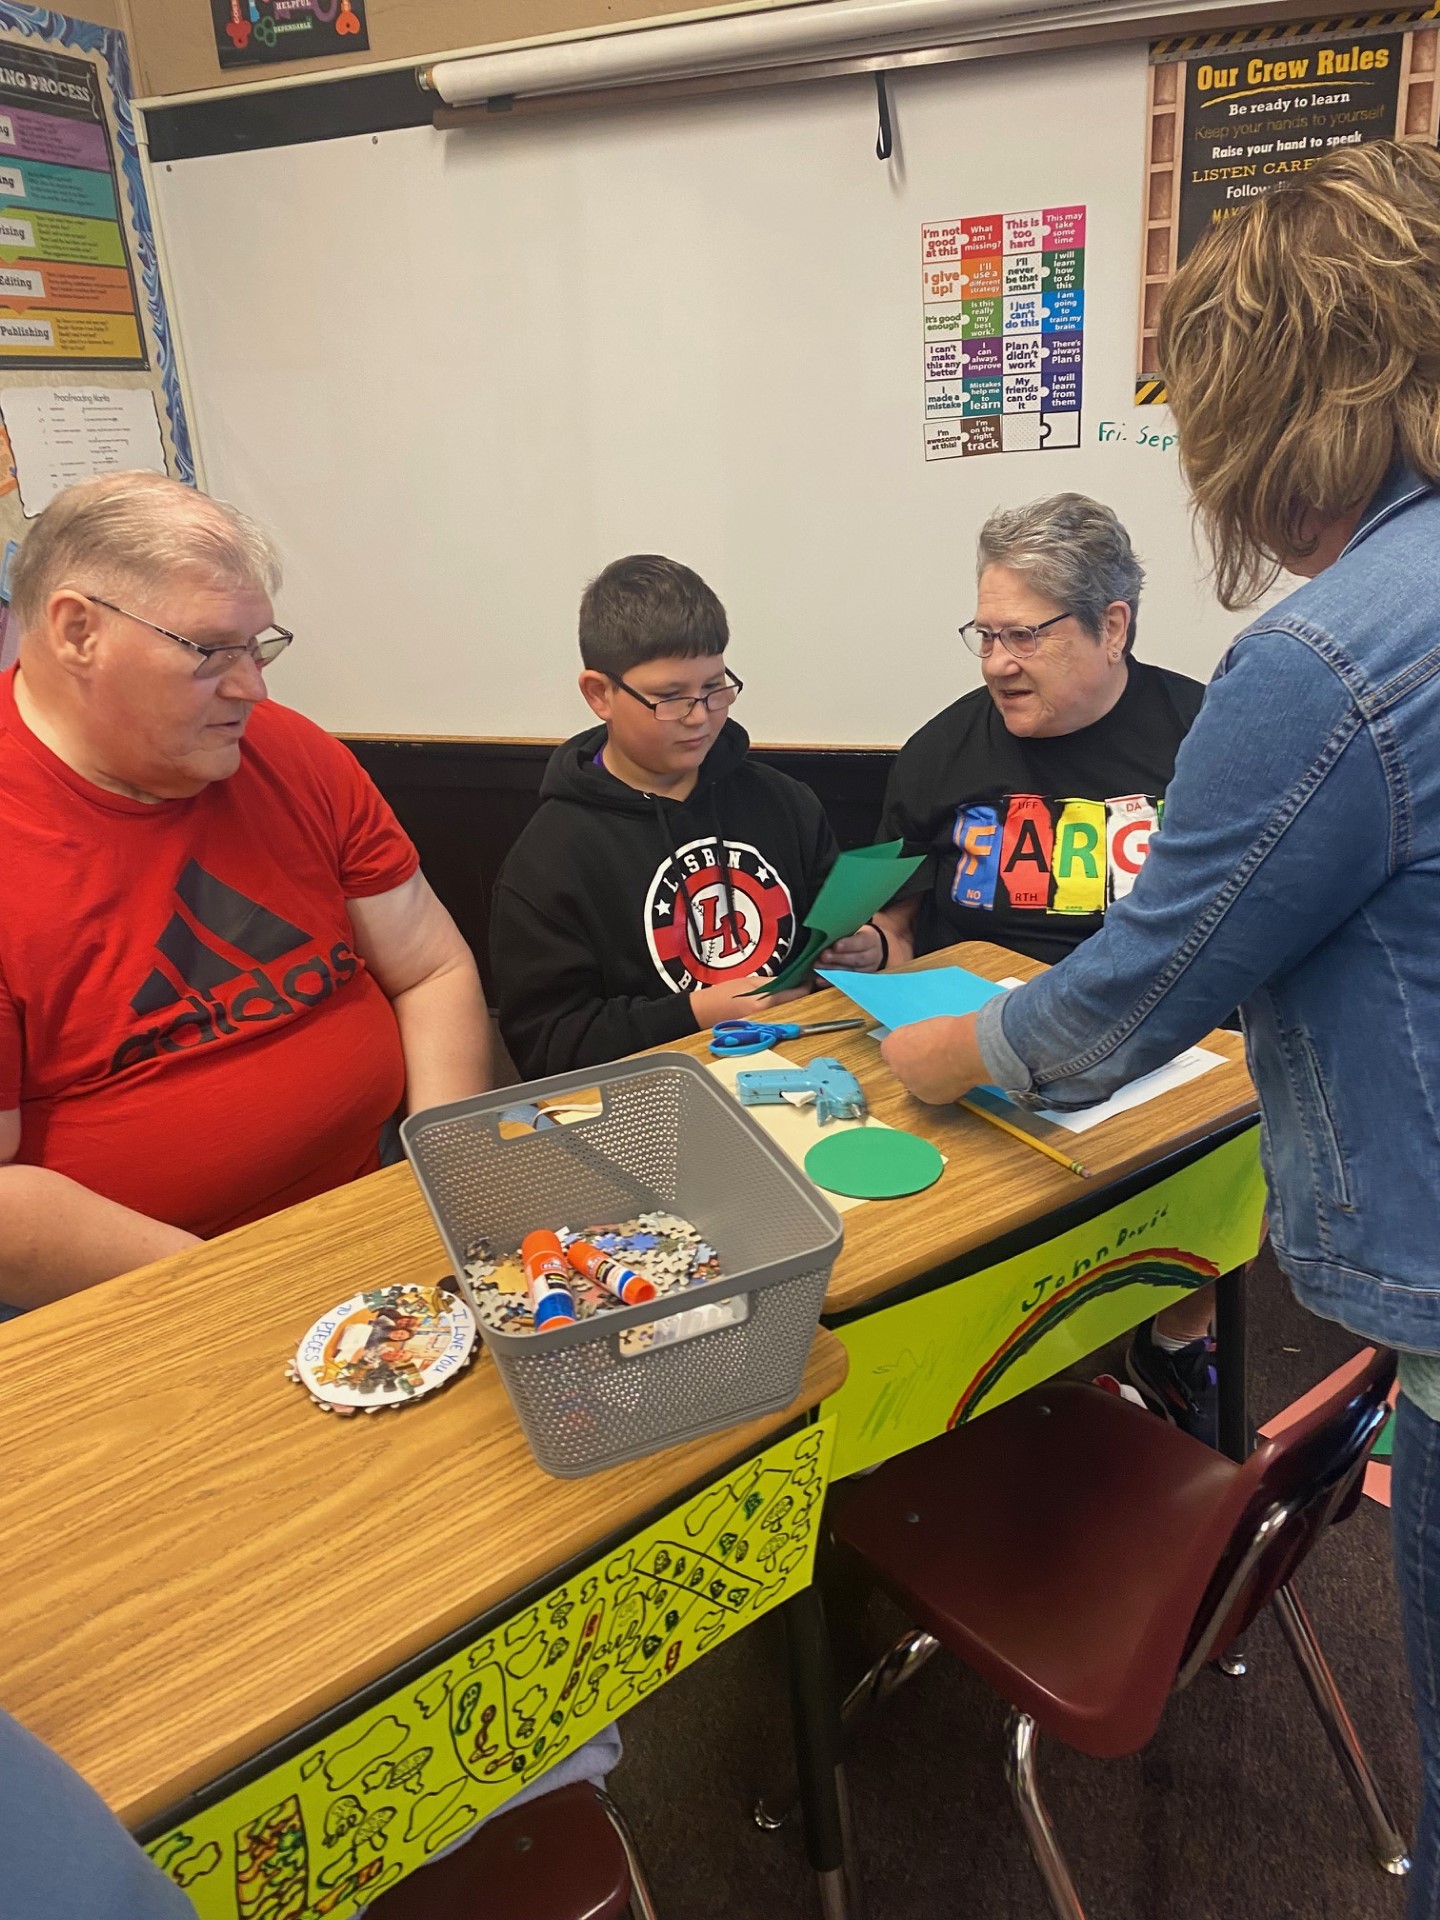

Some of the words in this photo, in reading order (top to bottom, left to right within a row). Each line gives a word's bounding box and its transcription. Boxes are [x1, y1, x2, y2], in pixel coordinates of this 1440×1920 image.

[276, 0, 312, 10] HELPFUL
[1197, 66, 1238, 91] Our
[1247, 57, 1308, 84] Crew
[1317, 46, 1390, 76] Rules
[28, 74, 91, 102] PROCESS
[1229, 104, 1247, 116] Be
[1251, 98, 1291, 114] ready
[1294, 97, 1308, 108] to
[1312, 93, 1351, 106] learn
[1195, 126, 1230, 140] Keep
[1232, 121, 1263, 138] your
[1267, 117, 1308, 132] hands
[1312, 114, 1327, 126] to
[1330, 104, 1386, 128] yourself
[1212, 146, 1243, 159] Raise
[1247, 142, 1274, 157] your
[1276, 137, 1306, 152] hand
[1310, 137, 1323, 148] to
[1327, 131, 1363, 147] speak
[1192, 164, 1257, 183] LISTEN
[1263, 157, 1322, 175] CARE
[1046, 214, 1063, 222] This
[1212, 205, 1247, 224] MAK
[1005, 219, 1028, 230] This
[1030, 218, 1039, 227] is
[1055, 221, 1074, 229] take
[923, 229, 939, 239] I'm
[942, 226, 960, 236] not
[970, 225, 993, 234] What
[1053, 229, 1075, 237] some
[1013, 230, 1032, 239] too
[928, 236, 956, 249] good
[965, 241, 1001, 251] missing?
[1010, 237, 1035, 249] hard
[926, 249, 936, 258] at
[938, 246, 958, 256] this
[1060, 251, 1075, 259] will
[1016, 257, 1027, 266] I'll
[979, 262, 992, 272] I'll
[1008, 267, 1035, 275] never
[1055, 267, 1073, 275] how
[924, 272, 928, 284] I
[931, 270, 960, 285] give
[973, 271, 990, 279] use
[1006, 275, 1017, 284] be
[1019, 274, 1038, 282] that
[0, 275, 33, 290] Editing
[969, 279, 1000, 287] different
[1056, 282, 1072, 290] this
[931, 282, 953, 296] up!
[1008, 283, 1035, 292] smart
[1010, 302, 1013, 310] I
[1016, 301, 1035, 311] just
[1054, 300, 1077, 308] going
[972, 307, 994, 315] really
[1010, 310, 1035, 319] can't
[939, 313, 961, 323] good
[976, 315, 989, 323] my
[927, 322, 959, 330] enough
[1005, 320, 1018, 328] do
[1020, 319, 1039, 327] this
[0, 325, 50, 341] Publishing
[971, 328, 995, 337] work?
[935, 344, 957, 353] can't
[1006, 342, 1029, 351] Plan
[1031, 341, 1039, 349] A
[1052, 340, 1081, 348] There's
[1006, 350, 1038, 360] didn't
[1052, 347, 1080, 355] always
[931, 353, 956, 361] make
[971, 355, 998, 363] always
[1052, 356, 1072, 364] Plan
[1074, 354, 1081, 363] B
[945, 361, 960, 369] any
[968, 363, 1002, 371] improve
[1008, 360, 1036, 369] work
[930, 369, 957, 377] better
[1058, 373, 1075, 381] will
[1015, 378, 1030, 386] My
[942, 386, 945, 394] I
[1005, 385, 1038, 394] friends
[1052, 390, 1075, 398] from
[928, 394, 953, 403] made
[1025, 393, 1037, 401] do
[927, 401, 961, 410] mistake
[970, 401, 1001, 410] learn
[927, 436, 961, 444] awesome
[973, 433, 992, 441] right
[1136, 425, 1179, 451] Sep
[967, 439, 999, 451] track
[1126, 802, 1142, 813] DA
[662, 847, 742, 893] LSBN
[966, 889, 981, 900] NO
[1015, 892, 1038, 902] RTH
[699, 895, 751, 959] LB
[110, 940, 358, 1076] adidas
[1021, 1246, 1109, 1313] John
[337, 1304, 352, 1316] TO
[453, 1308, 468, 1321] I
[304, 1321, 335, 1362] PIECES
[449, 1326, 470, 1351] LOVE
[433, 1354, 458, 1373] YOU
